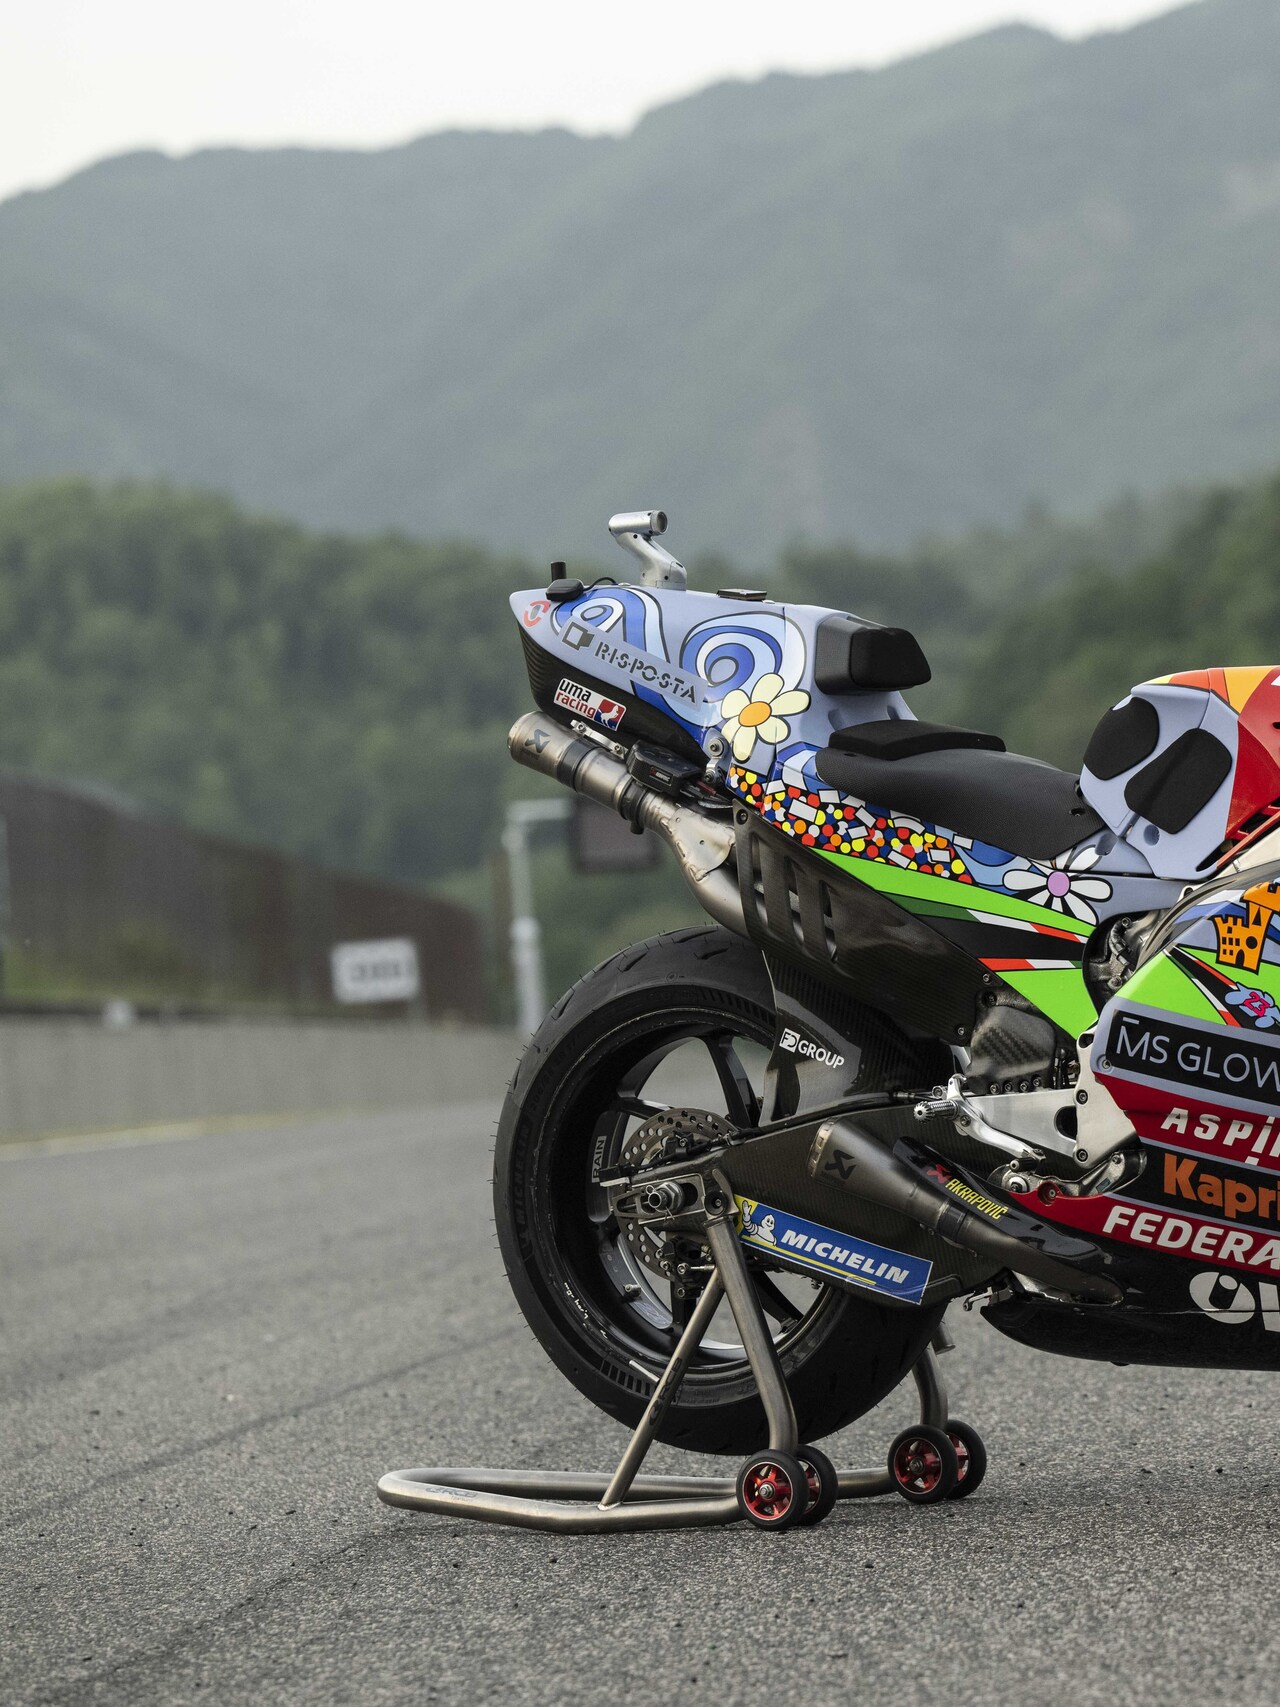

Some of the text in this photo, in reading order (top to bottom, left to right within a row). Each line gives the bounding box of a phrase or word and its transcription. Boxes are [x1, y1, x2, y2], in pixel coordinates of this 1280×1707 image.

[556, 692, 598, 719] racing
[559, 680, 592, 702] uma
[798, 1040, 845, 1068] GROUP
[1116, 1022, 1169, 1063] MS
[592, 1139, 605, 1179] RAIN
[781, 1229, 910, 1284] MICHELIN
